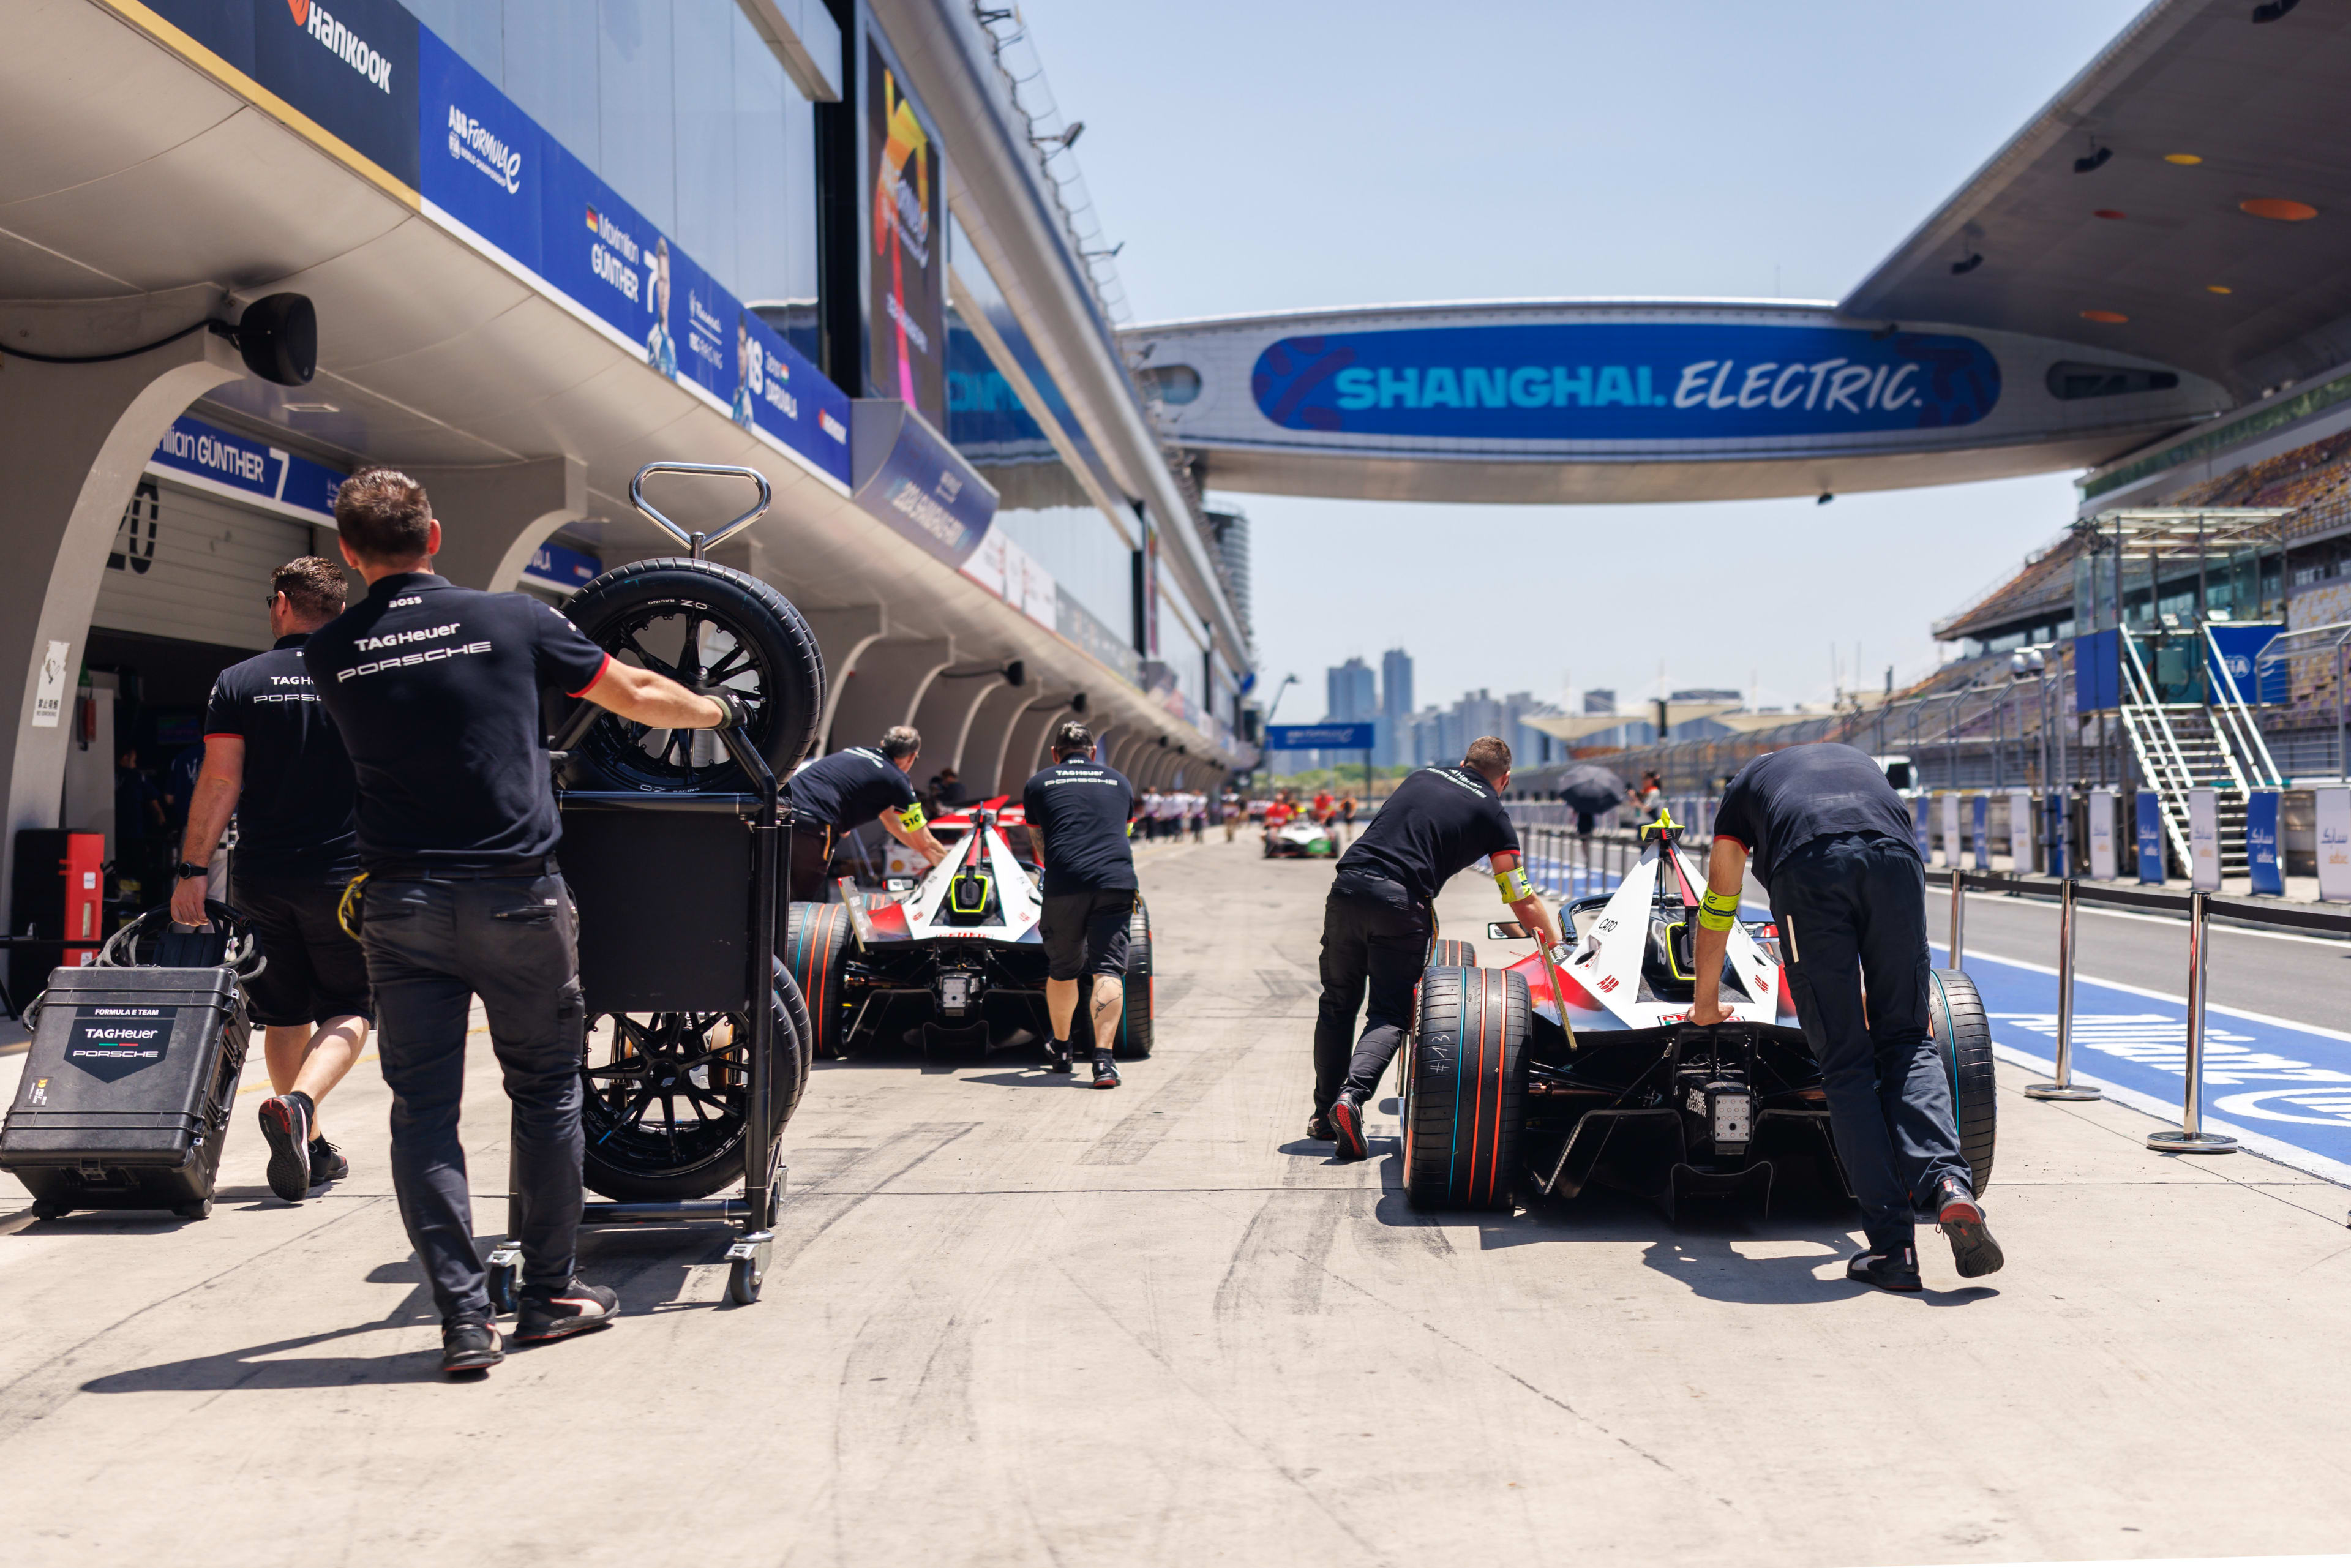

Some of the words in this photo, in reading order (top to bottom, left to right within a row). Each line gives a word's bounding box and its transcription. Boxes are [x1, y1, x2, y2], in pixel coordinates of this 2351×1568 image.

[643, 250, 659, 314] 7
[197, 435, 264, 484] GÜNTHER
[269, 447, 290, 502] 7
[336, 640, 492, 683] PORSCHE
[1044, 777, 1119, 787] PORSCHE
